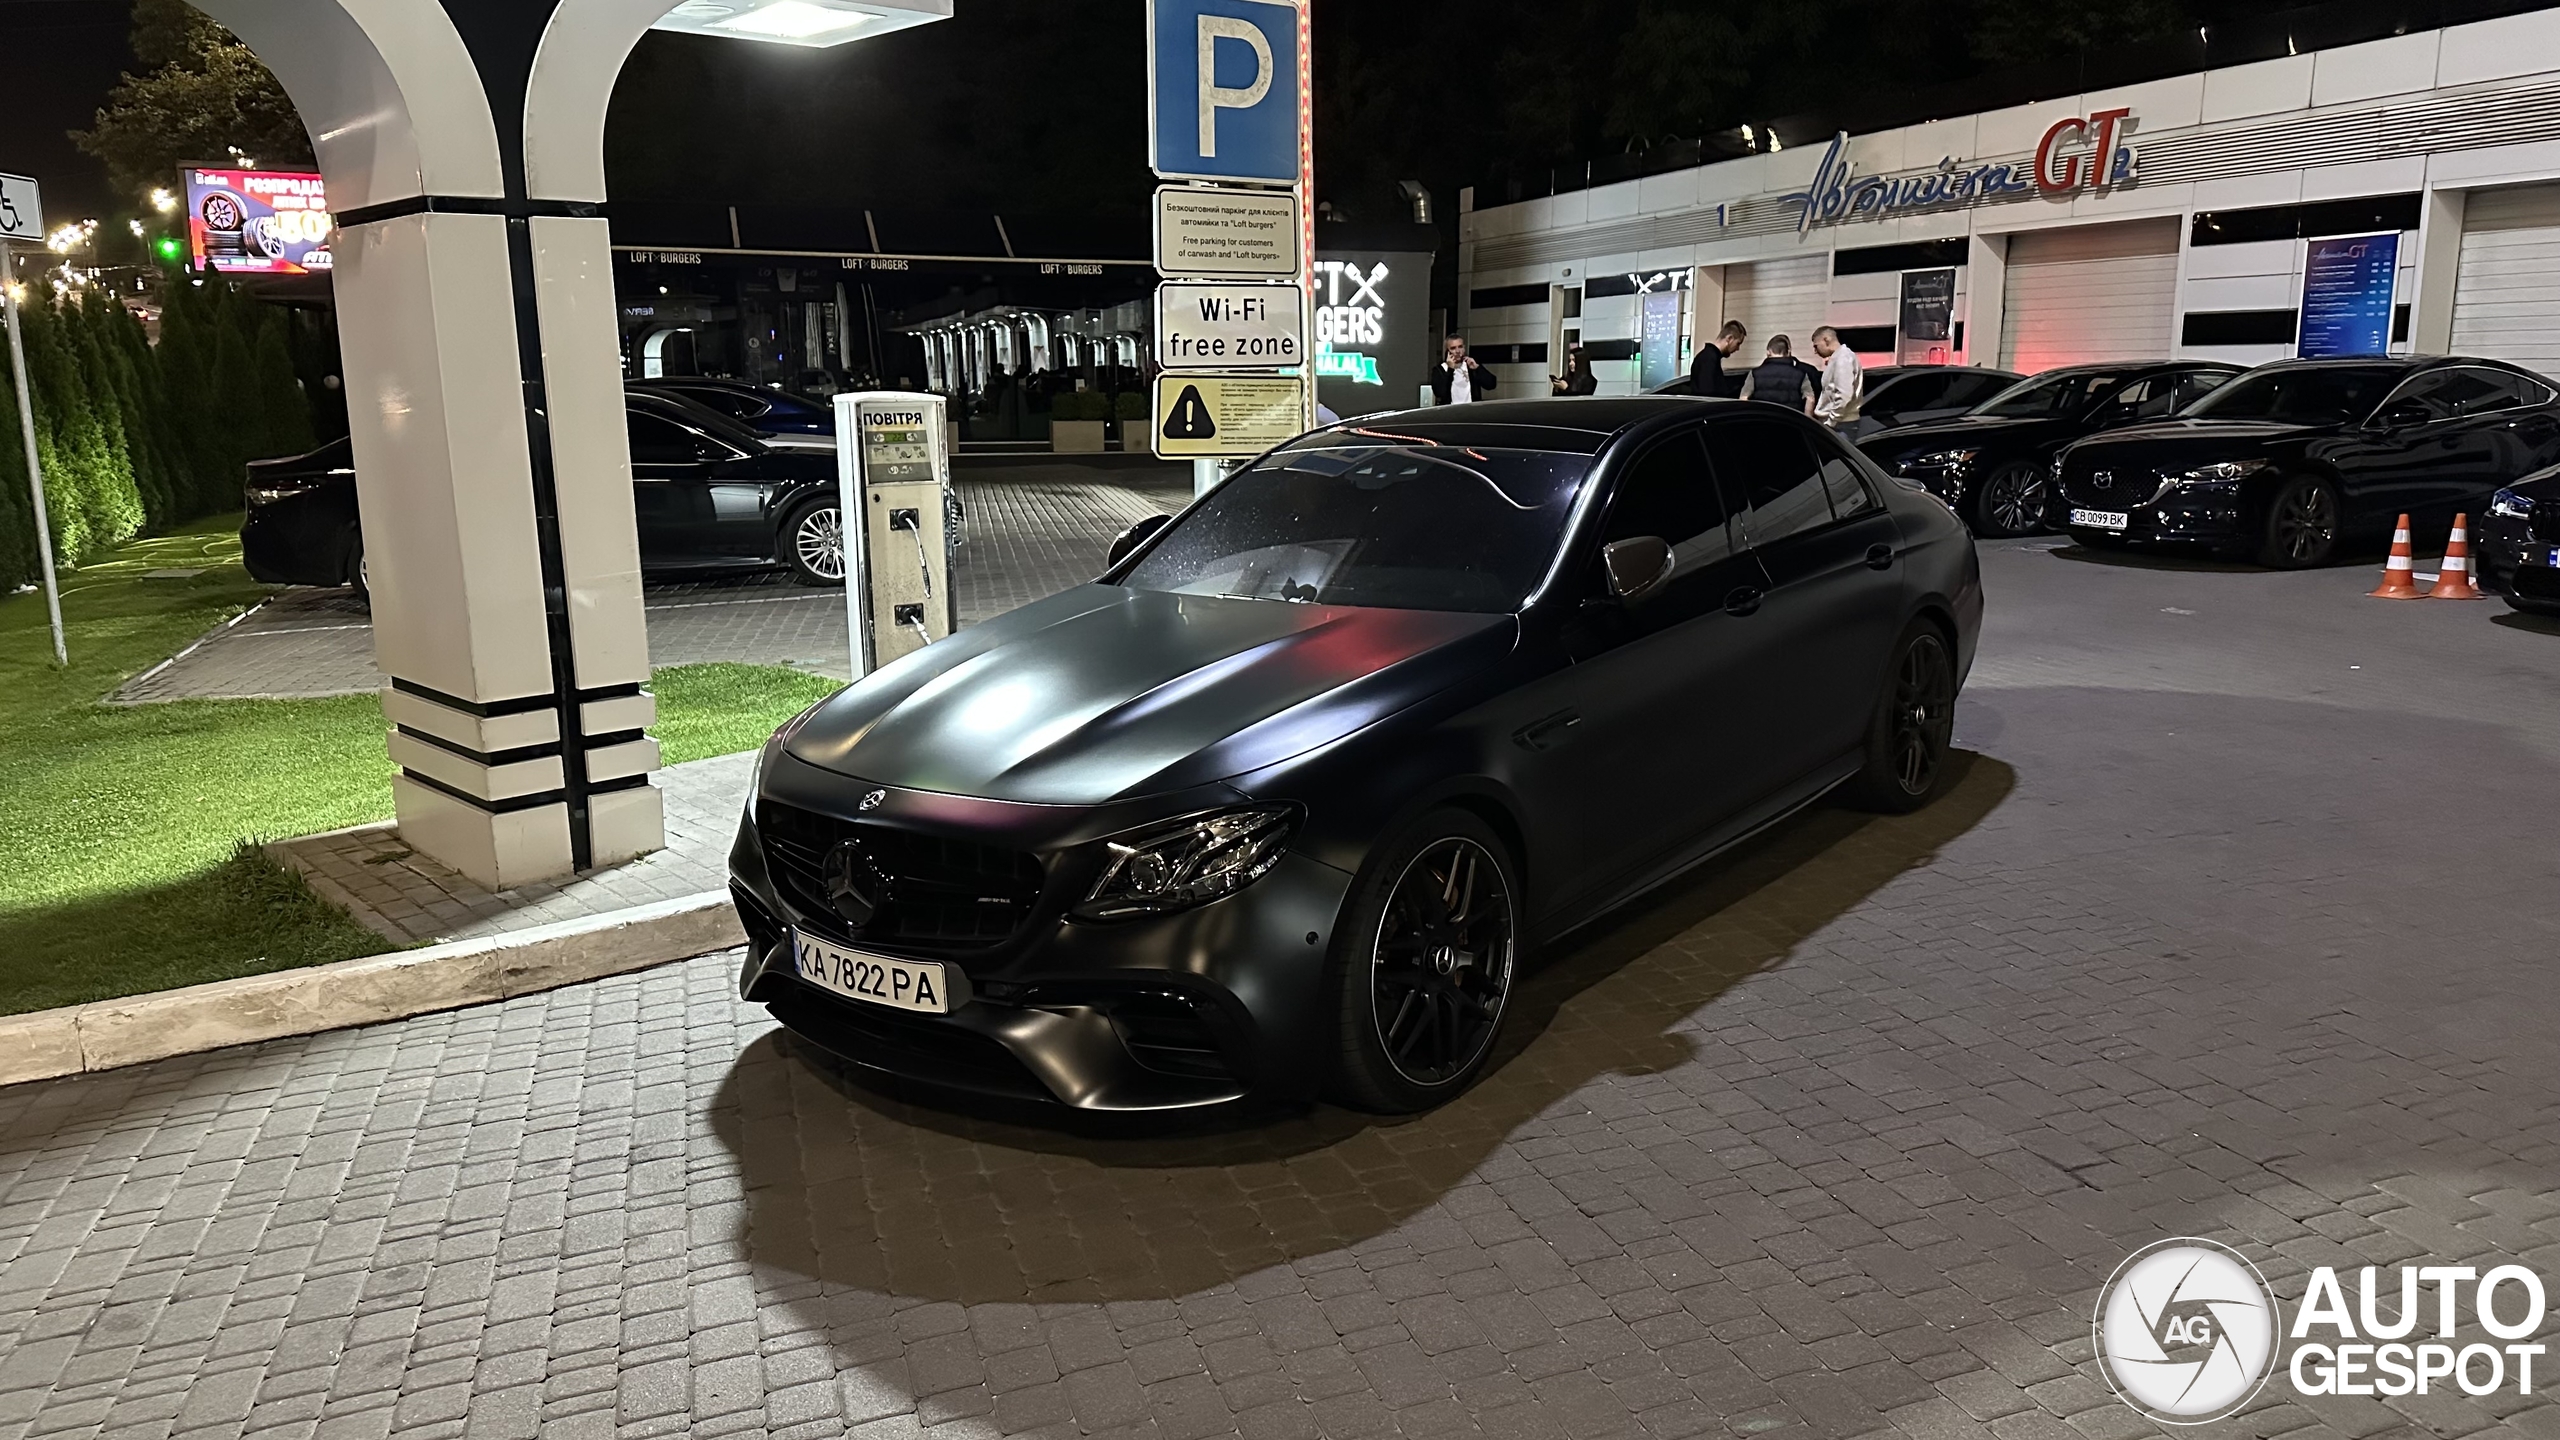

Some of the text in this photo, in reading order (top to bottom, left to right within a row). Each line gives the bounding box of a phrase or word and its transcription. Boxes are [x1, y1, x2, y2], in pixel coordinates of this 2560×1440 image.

[1198, 14, 1273, 157] P
[1777, 130, 2031, 232] Автомийка
[1166, 203, 1220, 213] Безкоштовний
[1221, 207, 1247, 216] паркінг
[1262, 209, 1289, 217] клієнтів
[1717, 204, 1729, 226] 1
[1180, 218, 1219, 227] автомийки
[1230, 219, 1247, 228] "Loft
[1248, 220, 1277, 230] burgers"
[1182, 236, 1274, 247] Free parking for customers
[630, 251, 701, 264] LOFT BURGERS
[1178, 249, 1186, 257] of
[1187, 249, 1216, 258] carwash
[1218, 250, 1232, 258] and
[841, 258, 909, 271] LOFT BURGERS
[1040, 263, 1103, 275] LOFT BURGERS
[1199, 298, 1265, 321] Wi-Fi
[1316, 306, 1383, 344] GERS
[1170, 333, 1225, 356] free
[1236, 338, 1294, 355] zone
[863, 412, 923, 425] ПОВІТРЯ
[2075, 511, 2124, 525] CB 0099 BK
[798, 940, 827, 981] KA
[829, 952, 887, 997] 7822
[892, 967, 937, 1005] PA
